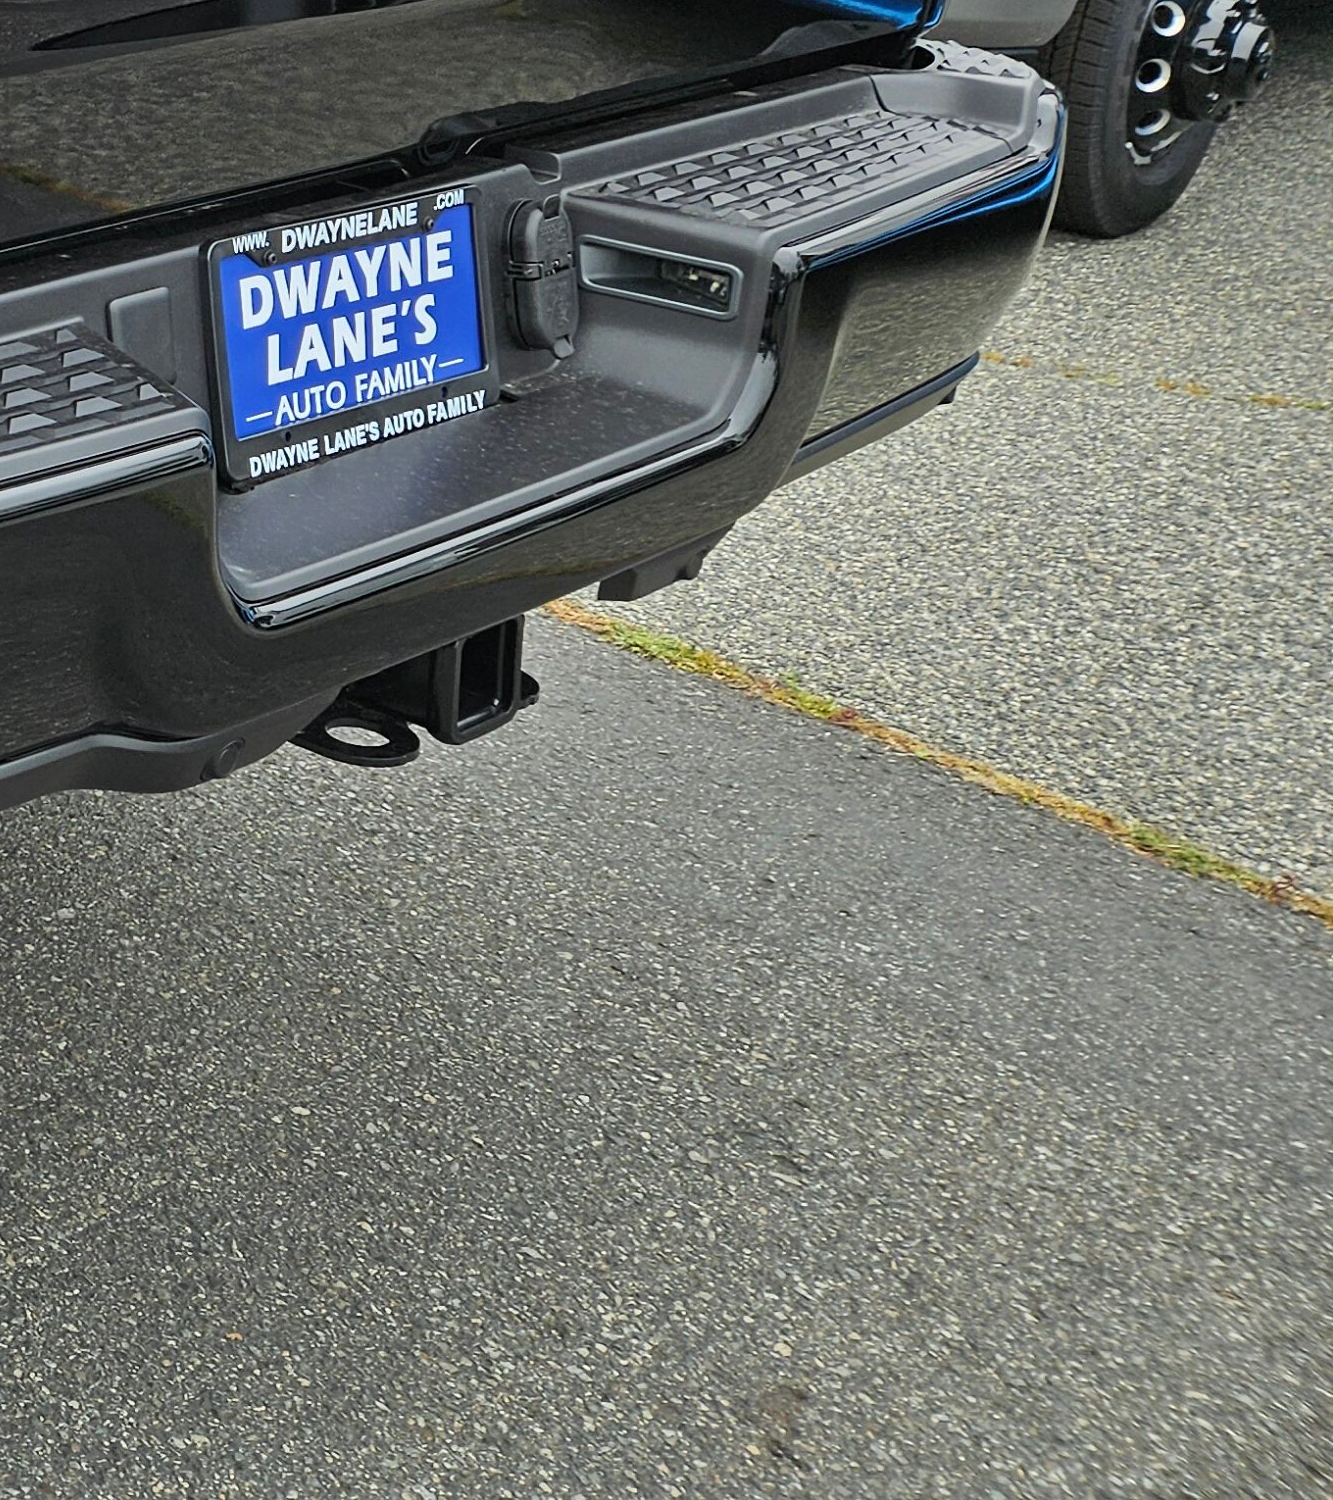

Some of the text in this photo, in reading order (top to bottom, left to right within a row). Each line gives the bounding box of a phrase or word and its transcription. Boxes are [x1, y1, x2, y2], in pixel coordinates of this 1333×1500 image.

[233, 189, 465, 254] WWW. DWAYNELANE .COM
[239, 231, 454, 330] DWAYNE
[267, 294, 438, 386] LANE'S
[249, 390, 487, 478] DWAYNE LANE'S AUTO FAMILY
[275, 354, 437, 426] AUTO FAMILY
